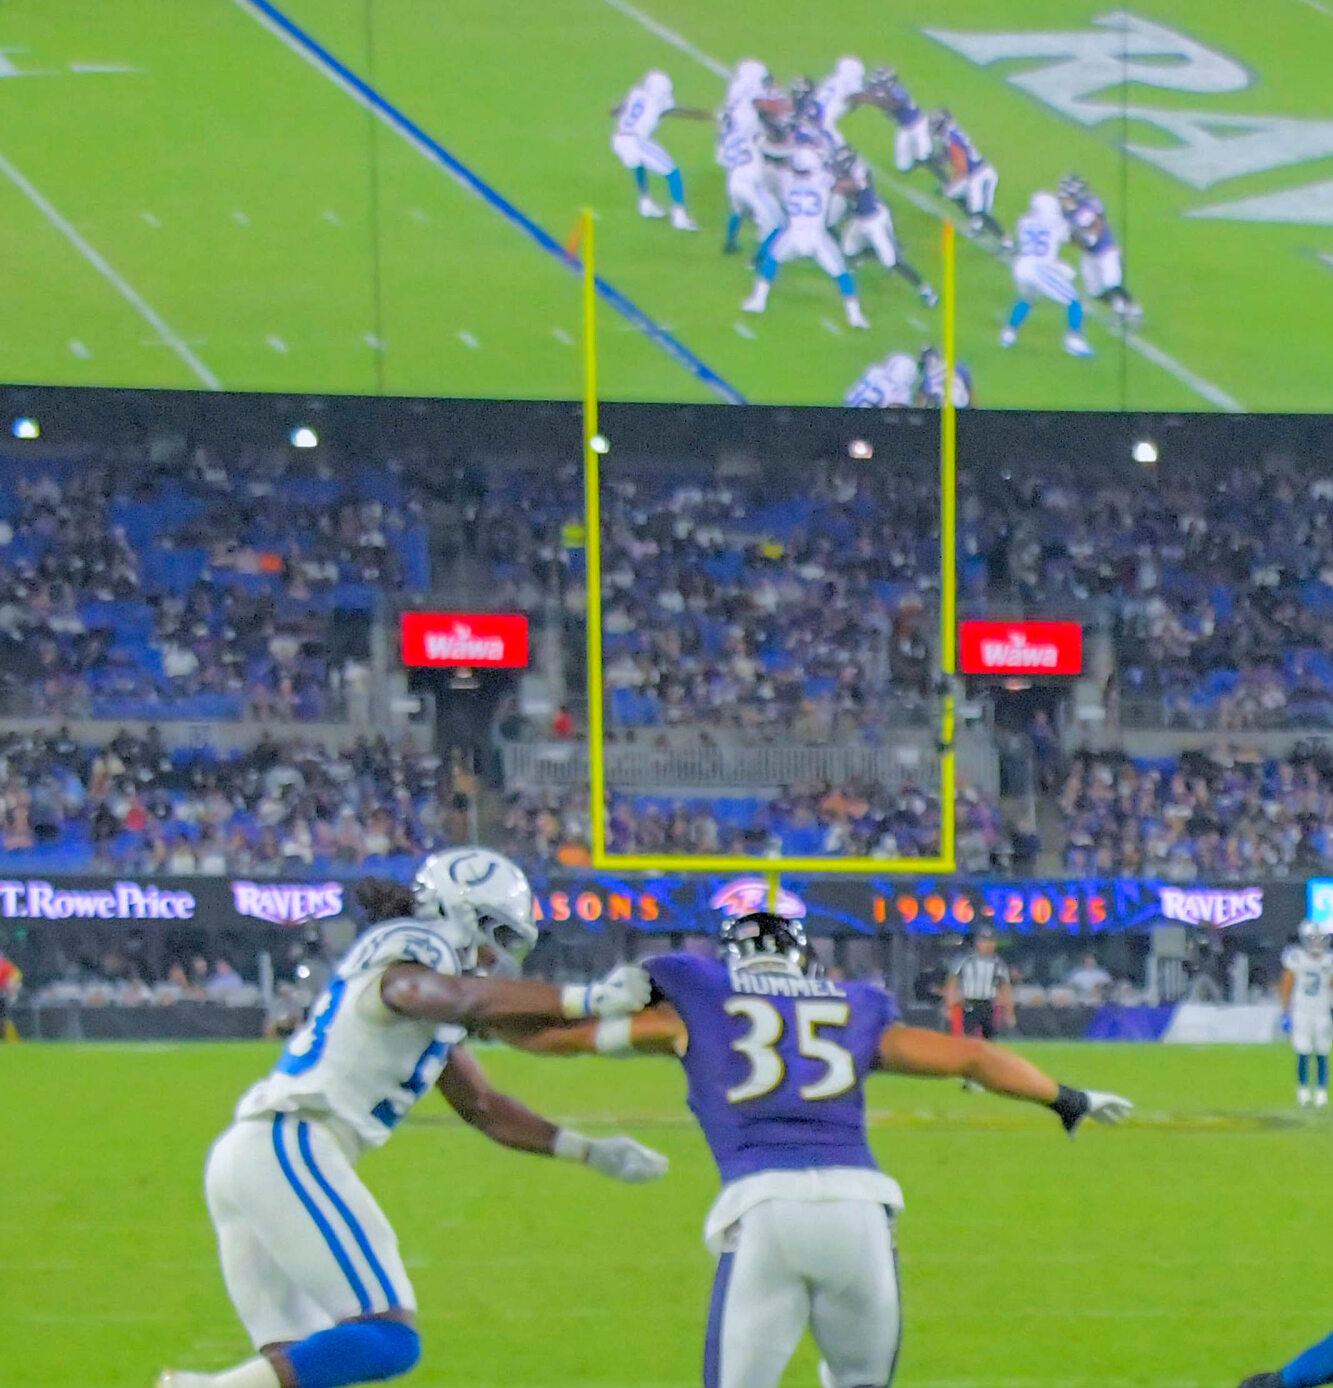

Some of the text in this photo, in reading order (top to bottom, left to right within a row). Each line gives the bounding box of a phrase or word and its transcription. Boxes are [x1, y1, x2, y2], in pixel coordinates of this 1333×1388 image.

[423, 632, 505, 660] Wawa
[981, 640, 1058, 668] Wawa
[233, 881, 344, 922] RAVENS
[1160, 886, 1264, 925] RAVENS
[732, 971, 847, 998] HUMMEL
[723, 996, 857, 1104] 35
